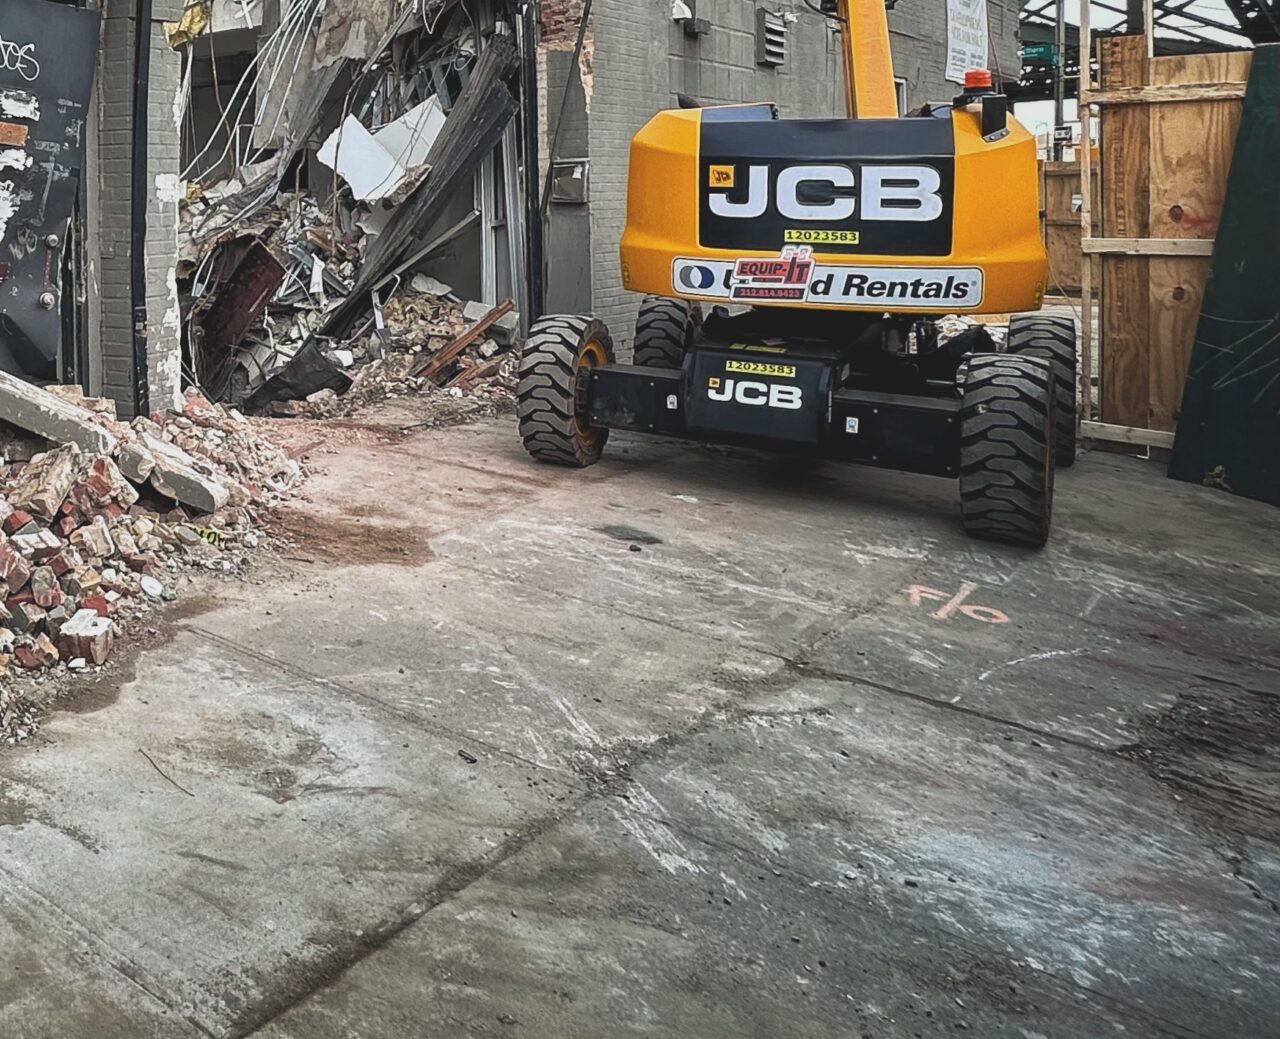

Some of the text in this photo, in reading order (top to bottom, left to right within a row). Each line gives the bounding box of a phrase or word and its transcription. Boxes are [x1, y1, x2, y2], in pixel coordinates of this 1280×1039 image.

[709, 165, 943, 221] JCB
[786, 230, 858, 242] 12023583
[842, 274, 970, 300] Rentals
[727, 361, 794, 375] 12023583
[707, 379, 802, 409] JCB
